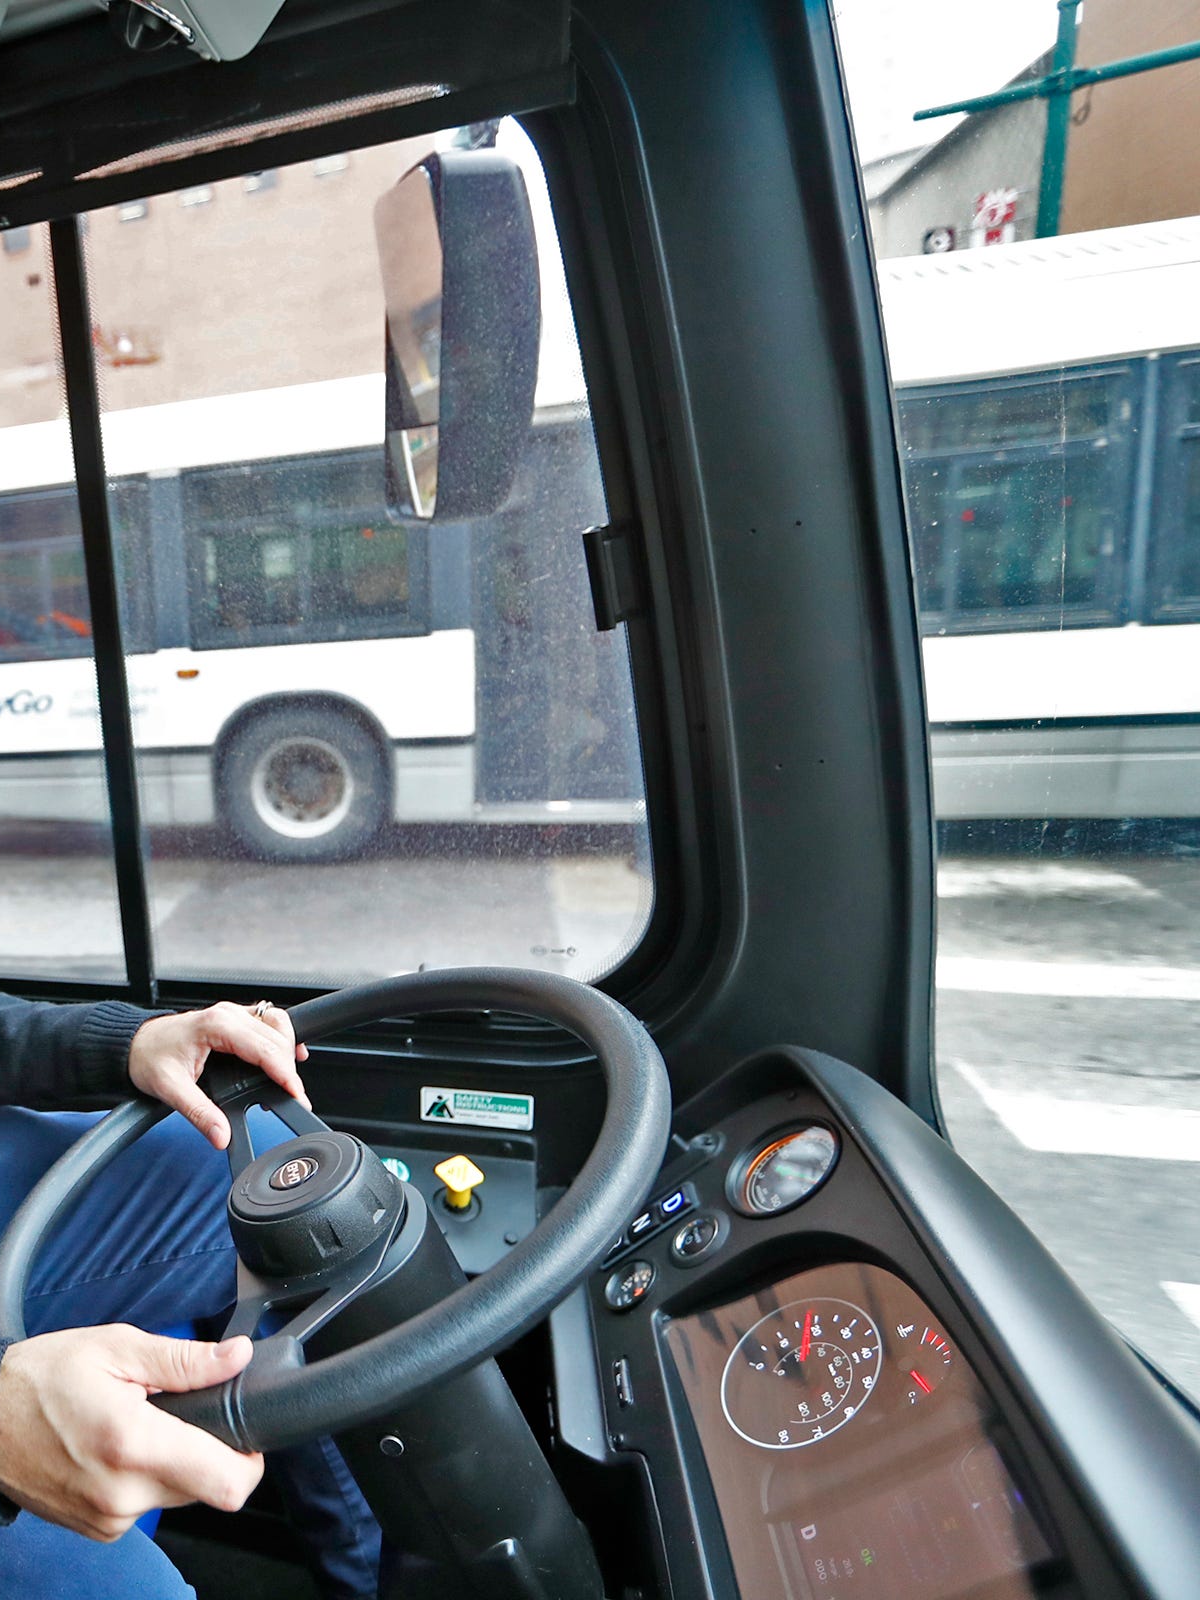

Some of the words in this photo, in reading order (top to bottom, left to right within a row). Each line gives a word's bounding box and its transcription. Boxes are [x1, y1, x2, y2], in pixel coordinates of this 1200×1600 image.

[286, 1162, 301, 1185] BYD
[662, 1191, 683, 1213] D
[631, 1212, 651, 1233] N
[810, 1324, 822, 1337] 20
[840, 1326, 852, 1339] 30
[779, 1338, 789, 1348] 10
[817, 1347, 826, 1357] 40
[861, 1347, 873, 1359] 40
[755, 1362, 765, 1371] 0
[833, 1356, 843, 1367] 60
[834, 1375, 845, 1389] 80
[861, 1375, 874, 1389] 50
[820, 1391, 833, 1407] 100
[797, 1401, 810, 1417] 120
[778, 1429, 789, 1443] 80
[812, 1426, 824, 1439] 70
[800, 1524, 816, 1540] D
[861, 1548, 873, 1567] OK
